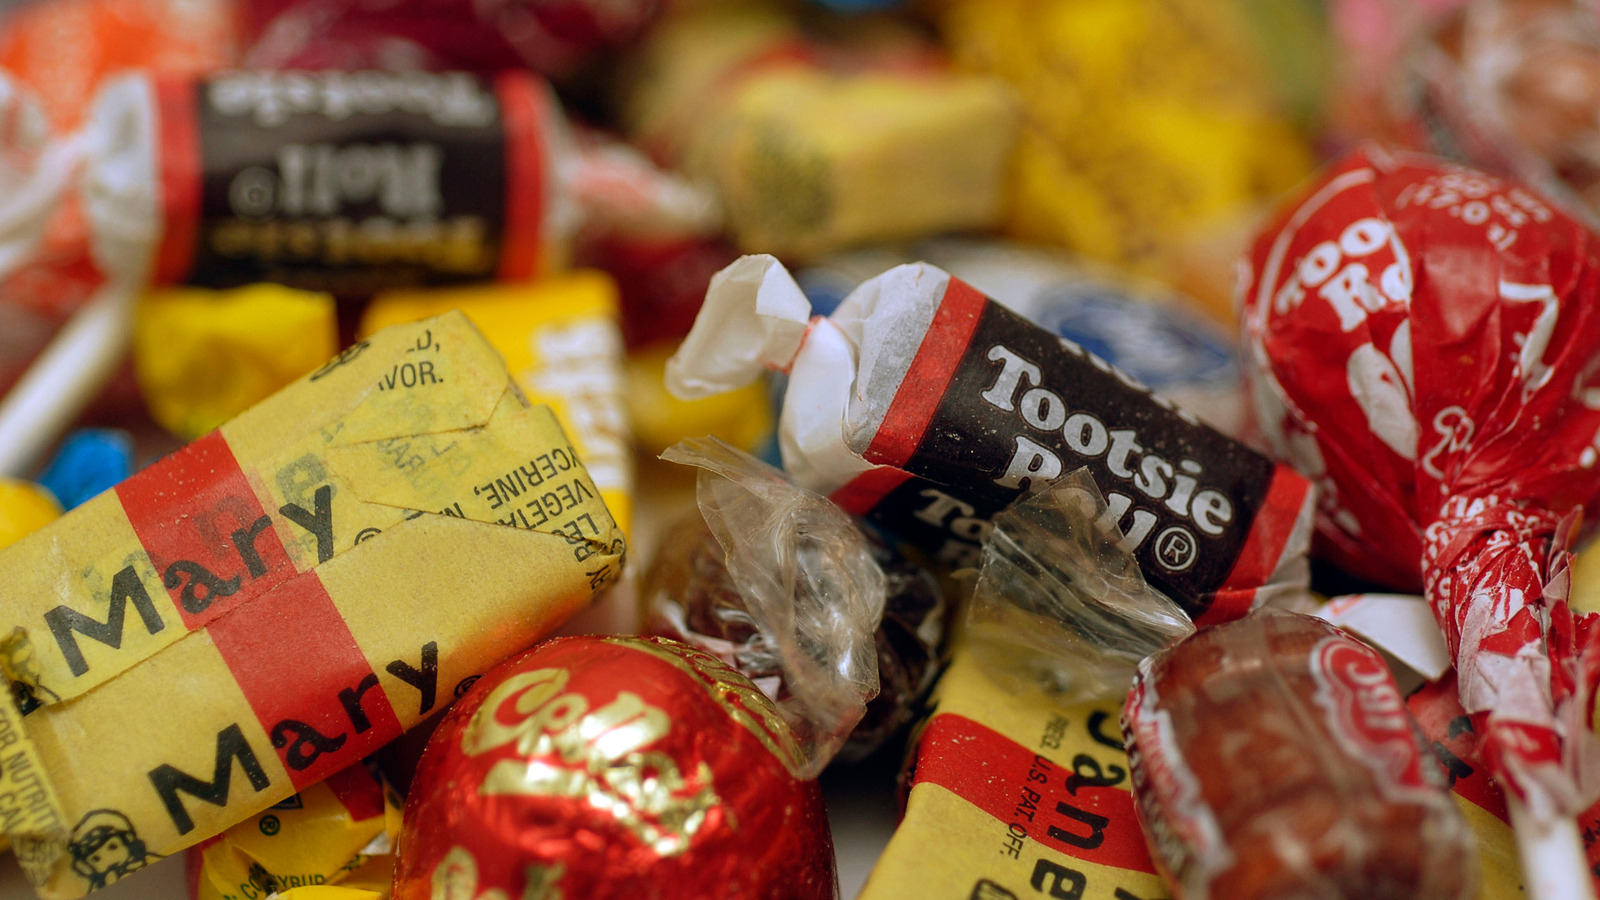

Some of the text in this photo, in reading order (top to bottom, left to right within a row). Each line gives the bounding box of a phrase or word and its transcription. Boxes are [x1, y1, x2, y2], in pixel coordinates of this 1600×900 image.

[378, 361, 444, 391] VOR.
[980, 344, 1233, 536] Tootsie
[43, 484, 334, 678] Mary
[147, 640, 439, 836] Mary
[1026, 754, 1053, 786] U.S.
[999, 822, 1028, 861] OFF.
[1013, 785, 1042, 823] PAT.
[1029, 709, 1128, 900] Jane
